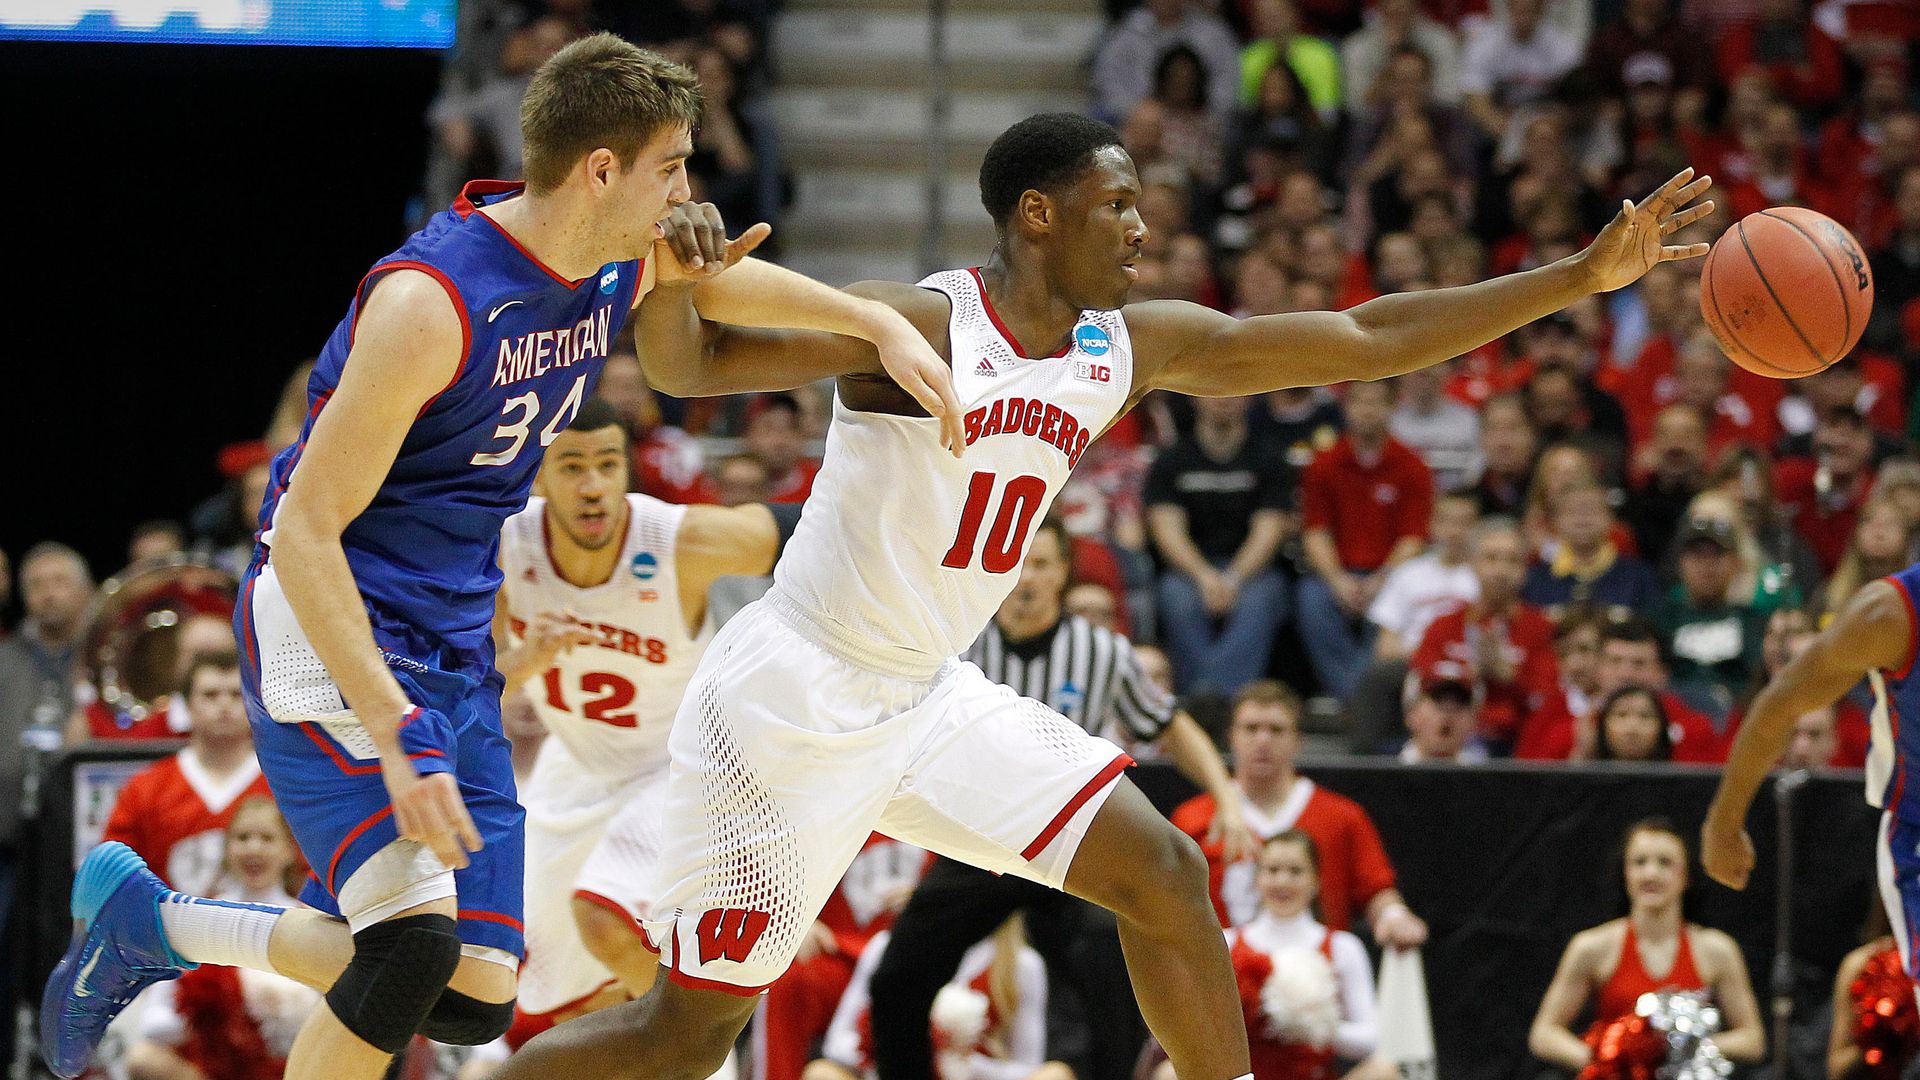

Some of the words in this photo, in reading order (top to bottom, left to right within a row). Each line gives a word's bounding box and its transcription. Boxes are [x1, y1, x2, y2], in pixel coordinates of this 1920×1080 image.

[1816, 220, 1869, 292] CAA
[974, 369, 998, 378] adidas
[1081, 338, 1109, 349] NCAA
[469, 373, 587, 466] 34
[950, 397, 1090, 471] BADGERS
[941, 471, 1047, 574] 10
[544, 667, 639, 728] 12
[695, 907, 771, 967] W
